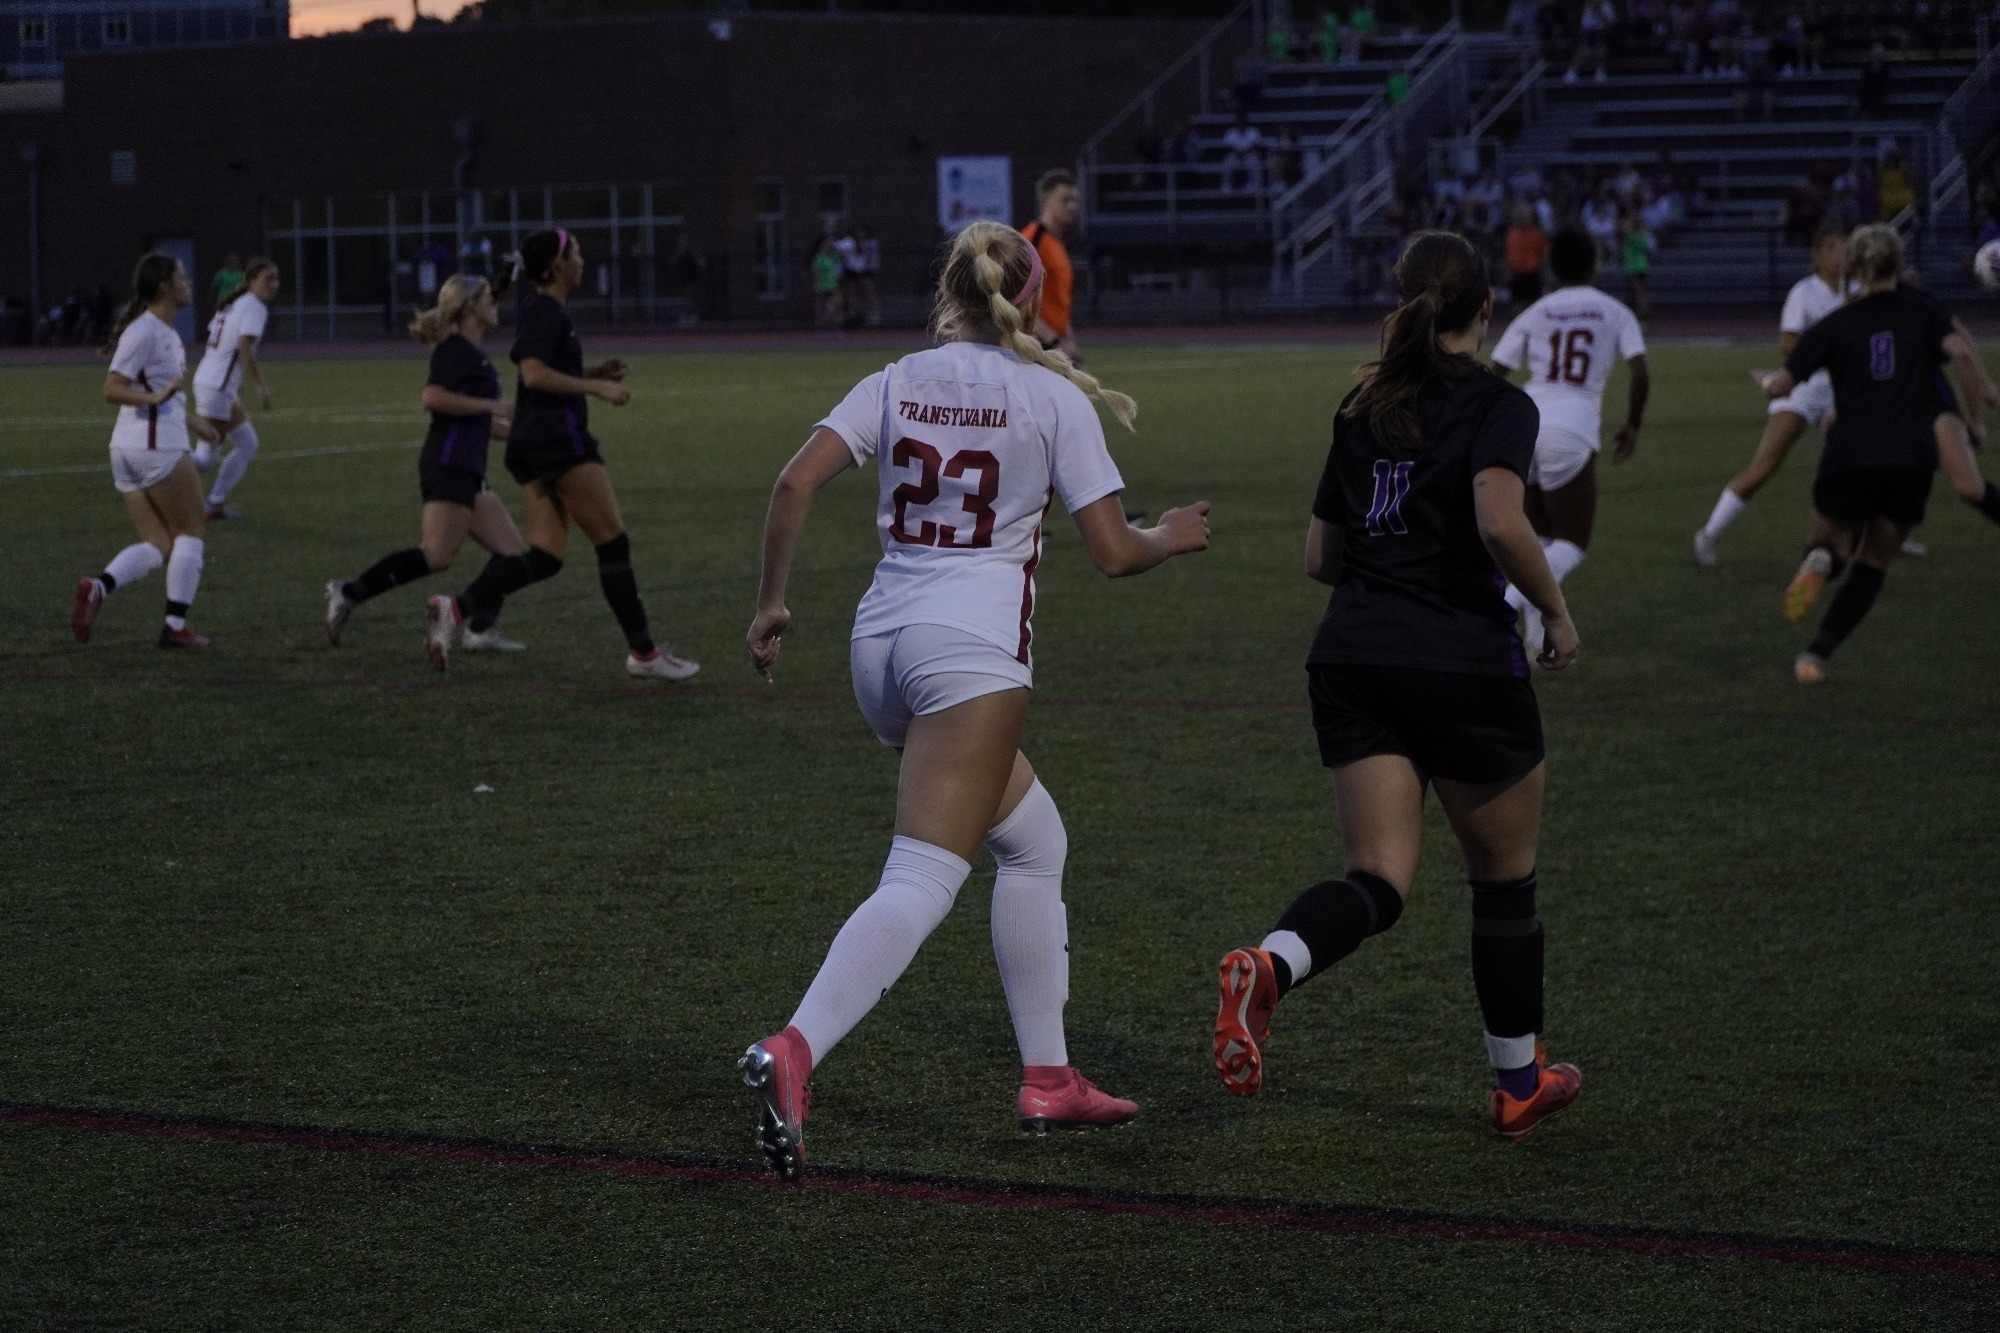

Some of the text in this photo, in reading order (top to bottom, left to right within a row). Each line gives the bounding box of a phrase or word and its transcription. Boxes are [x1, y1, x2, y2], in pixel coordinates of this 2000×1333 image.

[1546, 328, 1594, 386] 16
[1869, 330, 1895, 381] 8
[899, 400, 1007, 428] TRANSYLVANIA
[888, 436, 1000, 549] 23
[1365, 458, 1415, 537] 11
